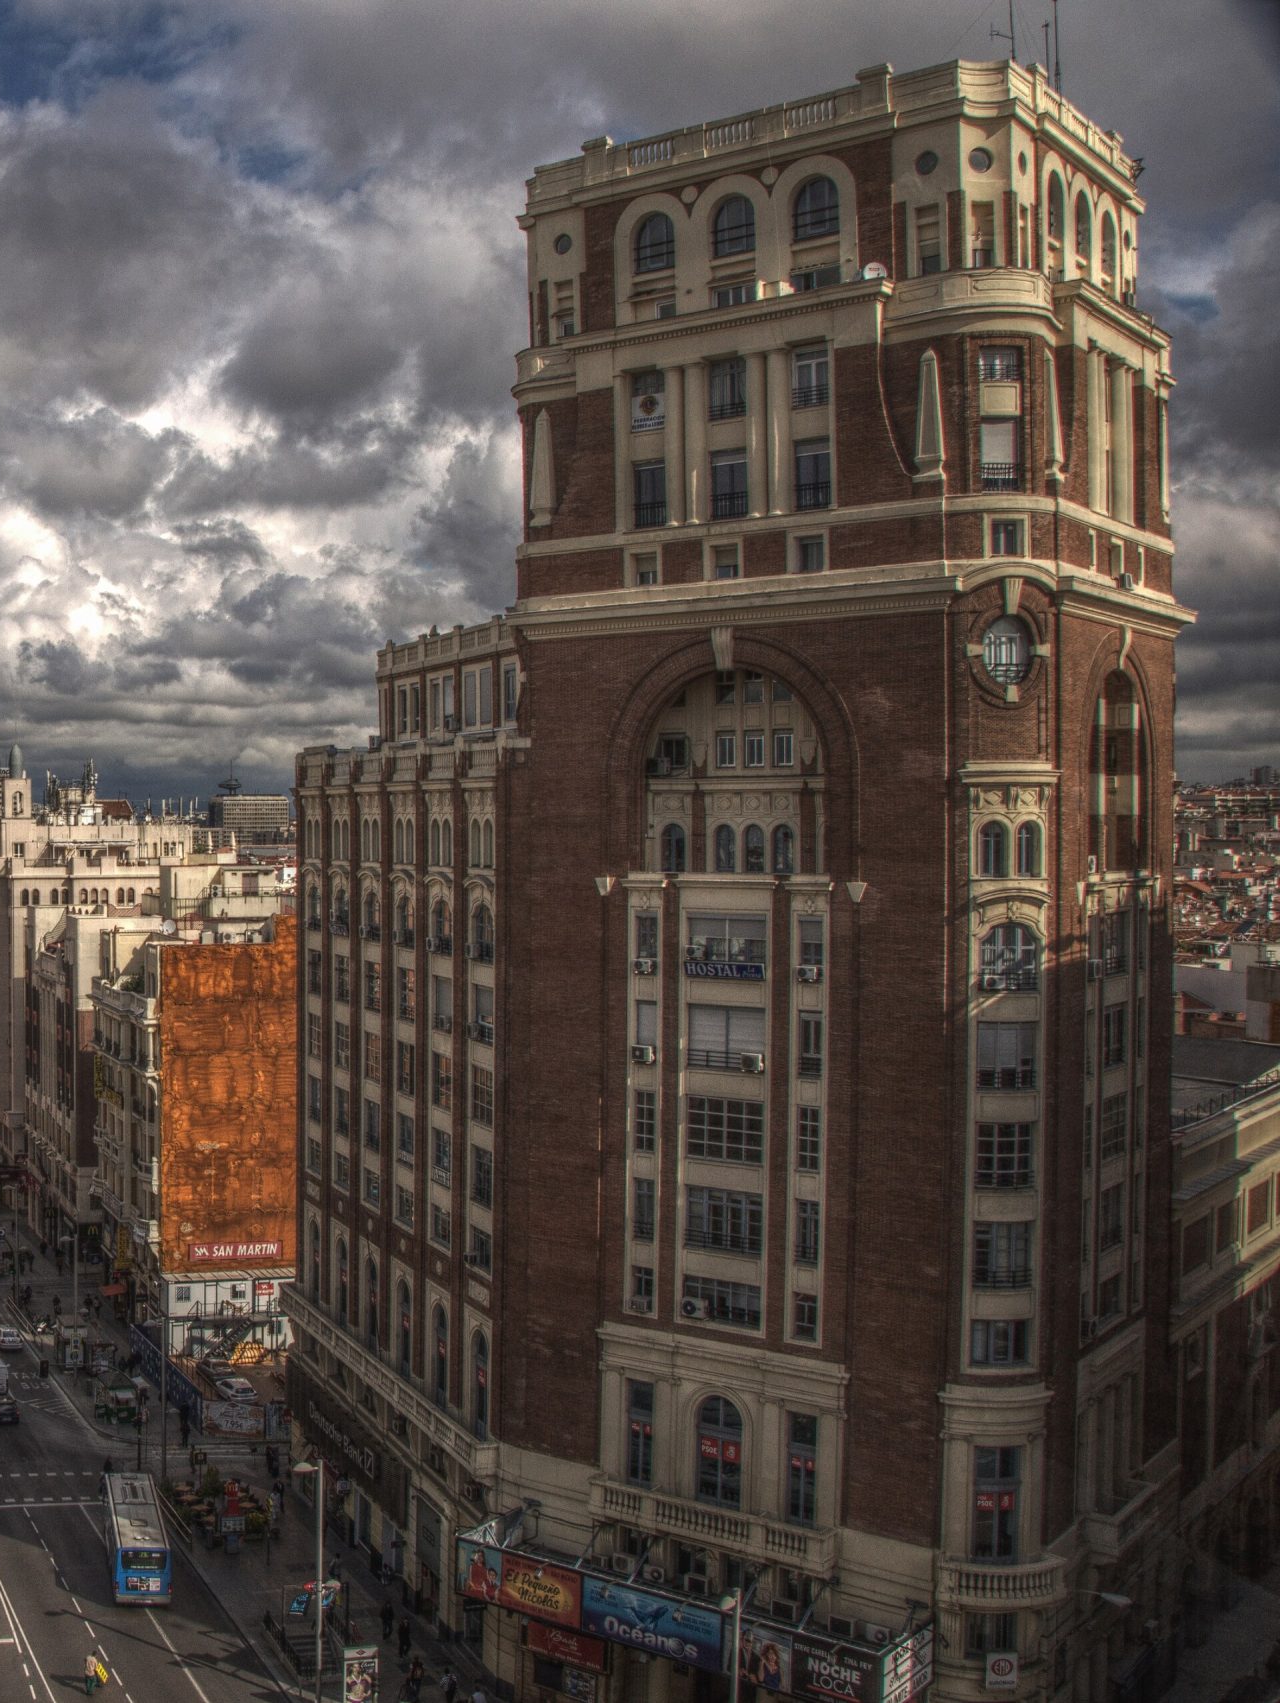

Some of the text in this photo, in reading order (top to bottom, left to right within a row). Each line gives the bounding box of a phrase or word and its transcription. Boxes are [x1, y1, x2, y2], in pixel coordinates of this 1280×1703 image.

[685, 962, 741, 977] HOSTAL
[212, 1244, 234, 1257] SAN
[236, 1242, 278, 1256] MARTIN
[20, 1381, 50, 1390] BUS
[309, 1400, 364, 1468] Deutsche Bank
[505, 1567, 520, 1584] El
[520, 1572, 561, 1596] Pequeño
[517, 1585, 560, 1610] Nicolás
[603, 1615, 699, 1659] Océanos
[794, 1642, 810, 1654] STEVE
[843, 1656, 858, 1667] TINA
[859, 1661, 873, 1671] FEY
[807, 1656, 861, 1686] NOCHE
[813, 1672, 855, 1697] LOCA
